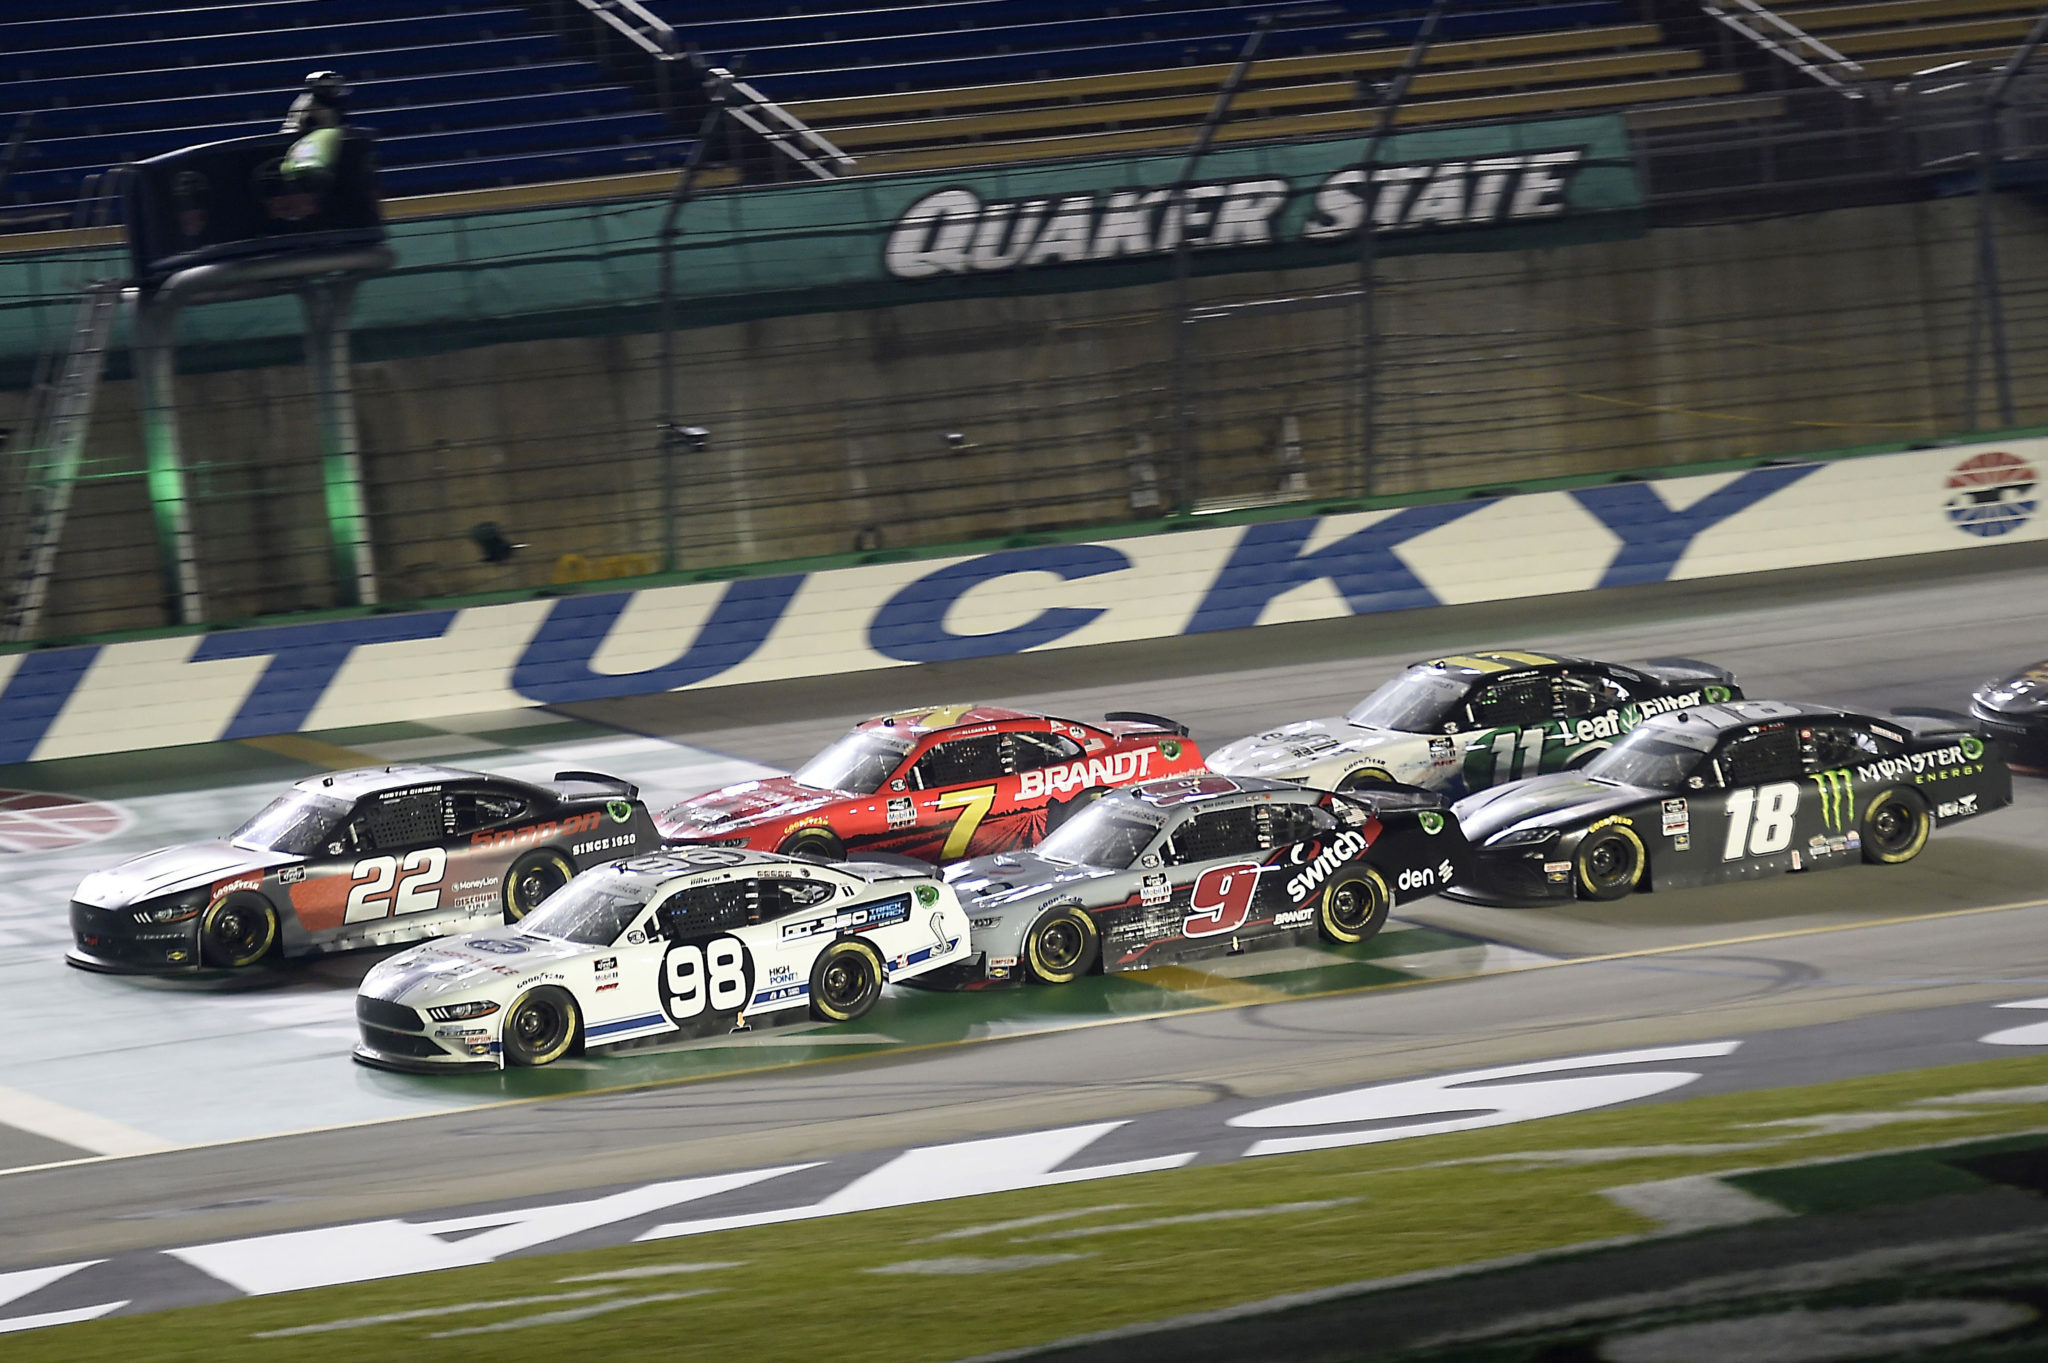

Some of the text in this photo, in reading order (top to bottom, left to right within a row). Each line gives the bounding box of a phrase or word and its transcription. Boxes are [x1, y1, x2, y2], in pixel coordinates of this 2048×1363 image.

[887, 148, 1584, 277] QUAKER STATE
[1559, 708, 1620, 746] Leaf
[1014, 747, 1157, 800] BRANDT
[1491, 728, 1544, 784] 11
[1857, 746, 1966, 782] MONSTER
[1916, 764, 1984, 784] ENERGY
[937, 784, 997, 859] 7
[1723, 782, 1800, 861] 18
[572, 833, 636, 856] SINCE 1920
[459, 876, 499, 890] MoneyLion
[1287, 829, 1369, 903] switch
[1399, 868, 1434, 891] den
[343, 847, 447, 924] 22
[1181, 860, 1261, 938] 9
[869, 902, 902, 914] TRACK
[869, 908, 905, 921] ATTACK
[1273, 908, 1315, 926] BRANDT
[667, 941, 749, 1019] 98
[769, 965, 790, 976] HIGH
[770, 974, 796, 985] POINT
